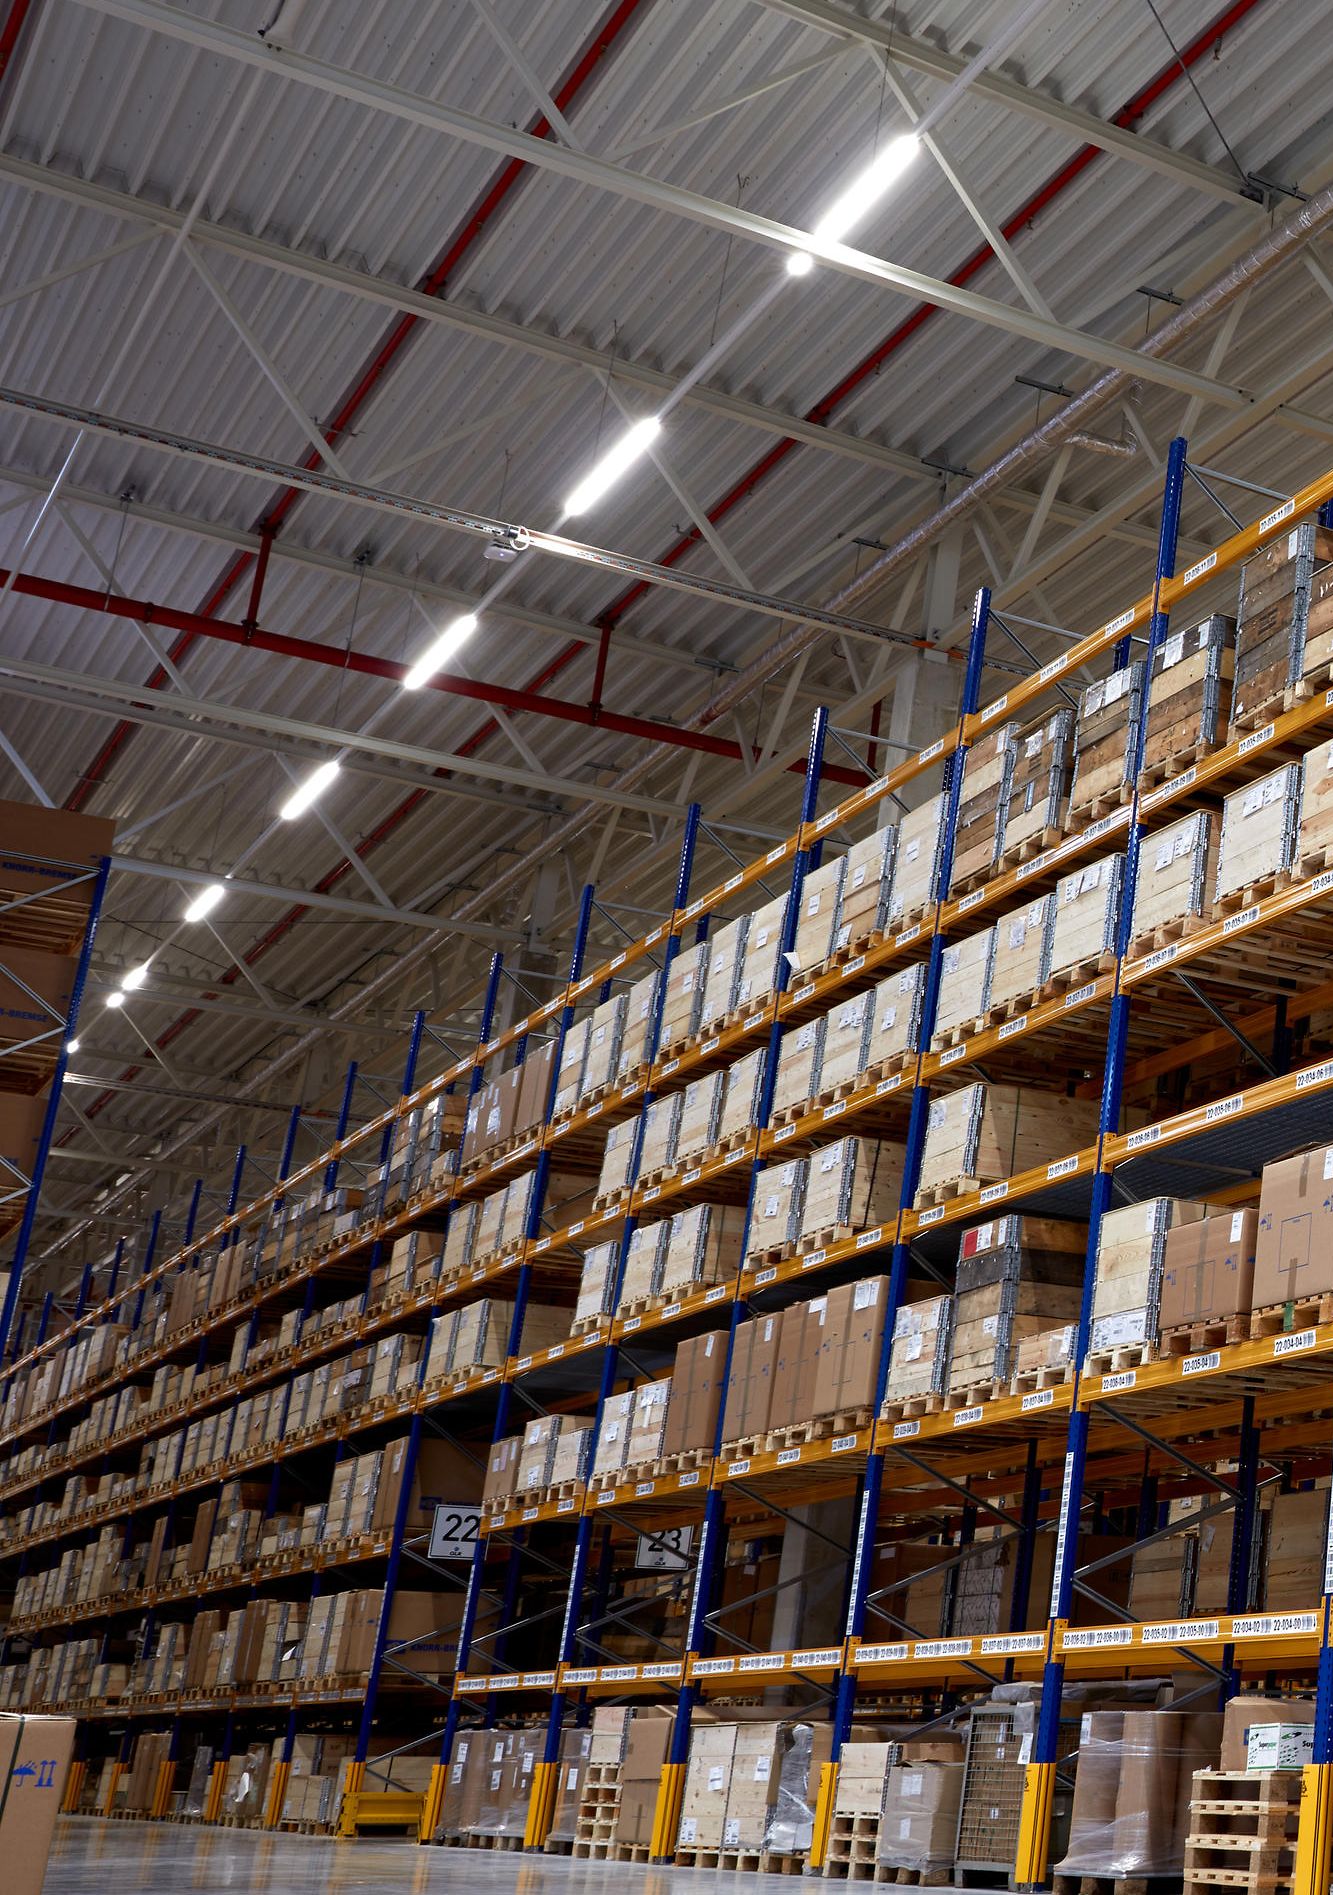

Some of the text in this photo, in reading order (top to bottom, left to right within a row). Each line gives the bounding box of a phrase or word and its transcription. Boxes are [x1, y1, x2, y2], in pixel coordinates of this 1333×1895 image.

[1297, 1068, 1324, 1086] 22-034-06
[1275, 1338, 1303, 1353] 22-034-04
[1183, 1357, 1208, 1371] 22-035-04
[442, 1514, 480, 1542] 22
[648, 1528, 682, 1552] 23
[1143, 1624, 1205, 1641] 22-035-02 22-035-00
[1234, 1617, 1301, 1634] 22-034-02 22-034-00
